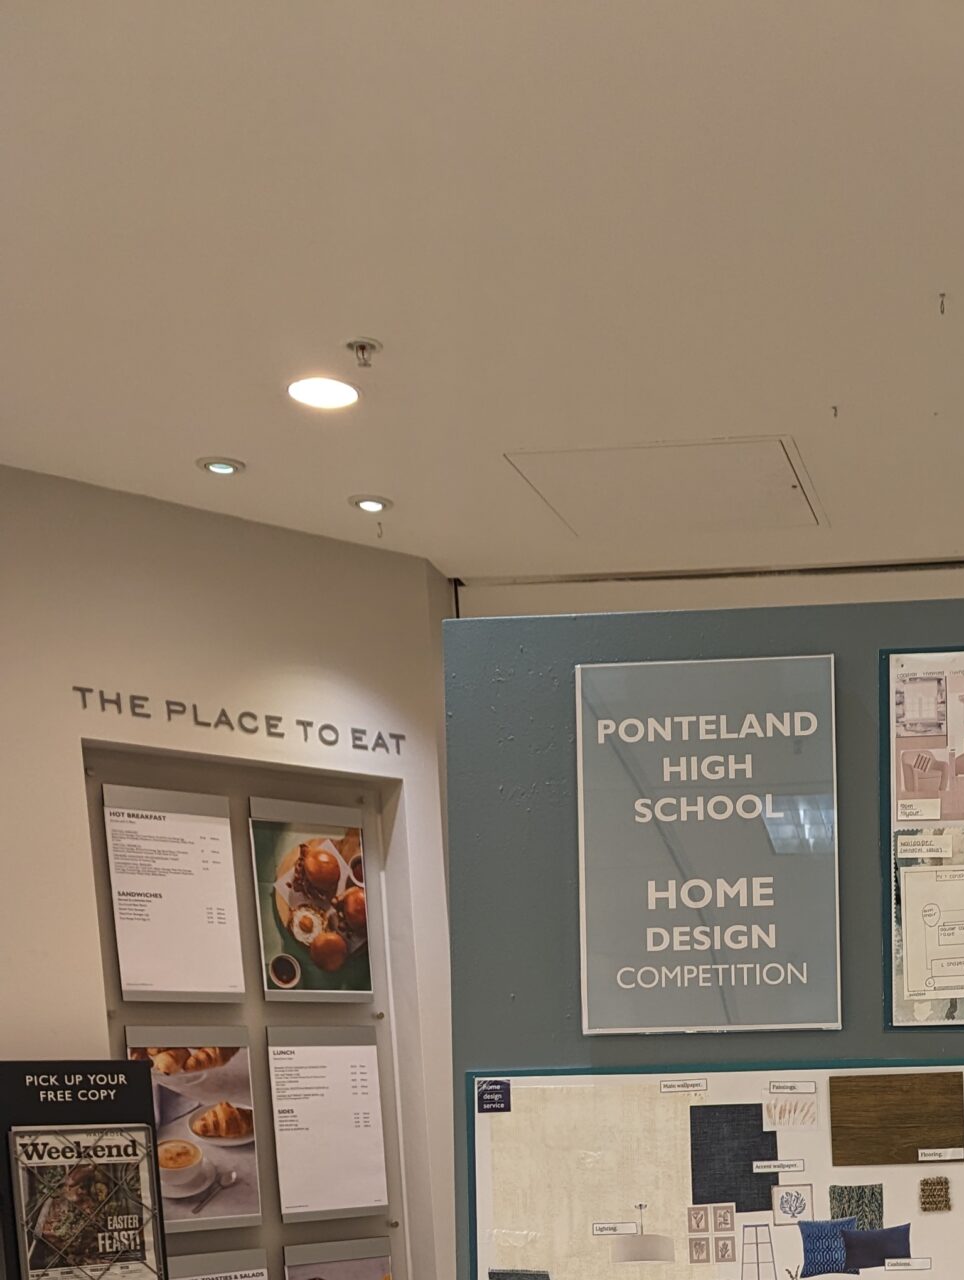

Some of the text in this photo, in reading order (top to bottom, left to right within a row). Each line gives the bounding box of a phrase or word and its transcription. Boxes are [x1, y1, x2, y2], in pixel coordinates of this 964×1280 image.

[72, 685, 406, 756] THE PLACE TO EAT
[597, 711, 818, 744] PONTELAND
[663, 754, 752, 782] HIGH
[127, 812, 167, 821] BREAKFAST
[634, 794, 784, 823] SCHOOL
[117, 890, 163, 899] SANDWICHES
[647, 876, 775, 910] HOME
[646, 923, 776, 952] DESIGN
[616, 962, 808, 989] COMPETITION
[25, 1073, 128, 1087] PICK UP YOUR
[39, 1088, 117, 1102] FREE COPY
[483, 1092, 503, 1101] design
[483, 1101, 505, 1109] service
[19, 1140, 139, 1161] Weekend
[107, 1215, 139, 1230] EASTER
[98, 1231, 141, 1253] FEAST!
[240, 1271, 264, 1279] SALADS
